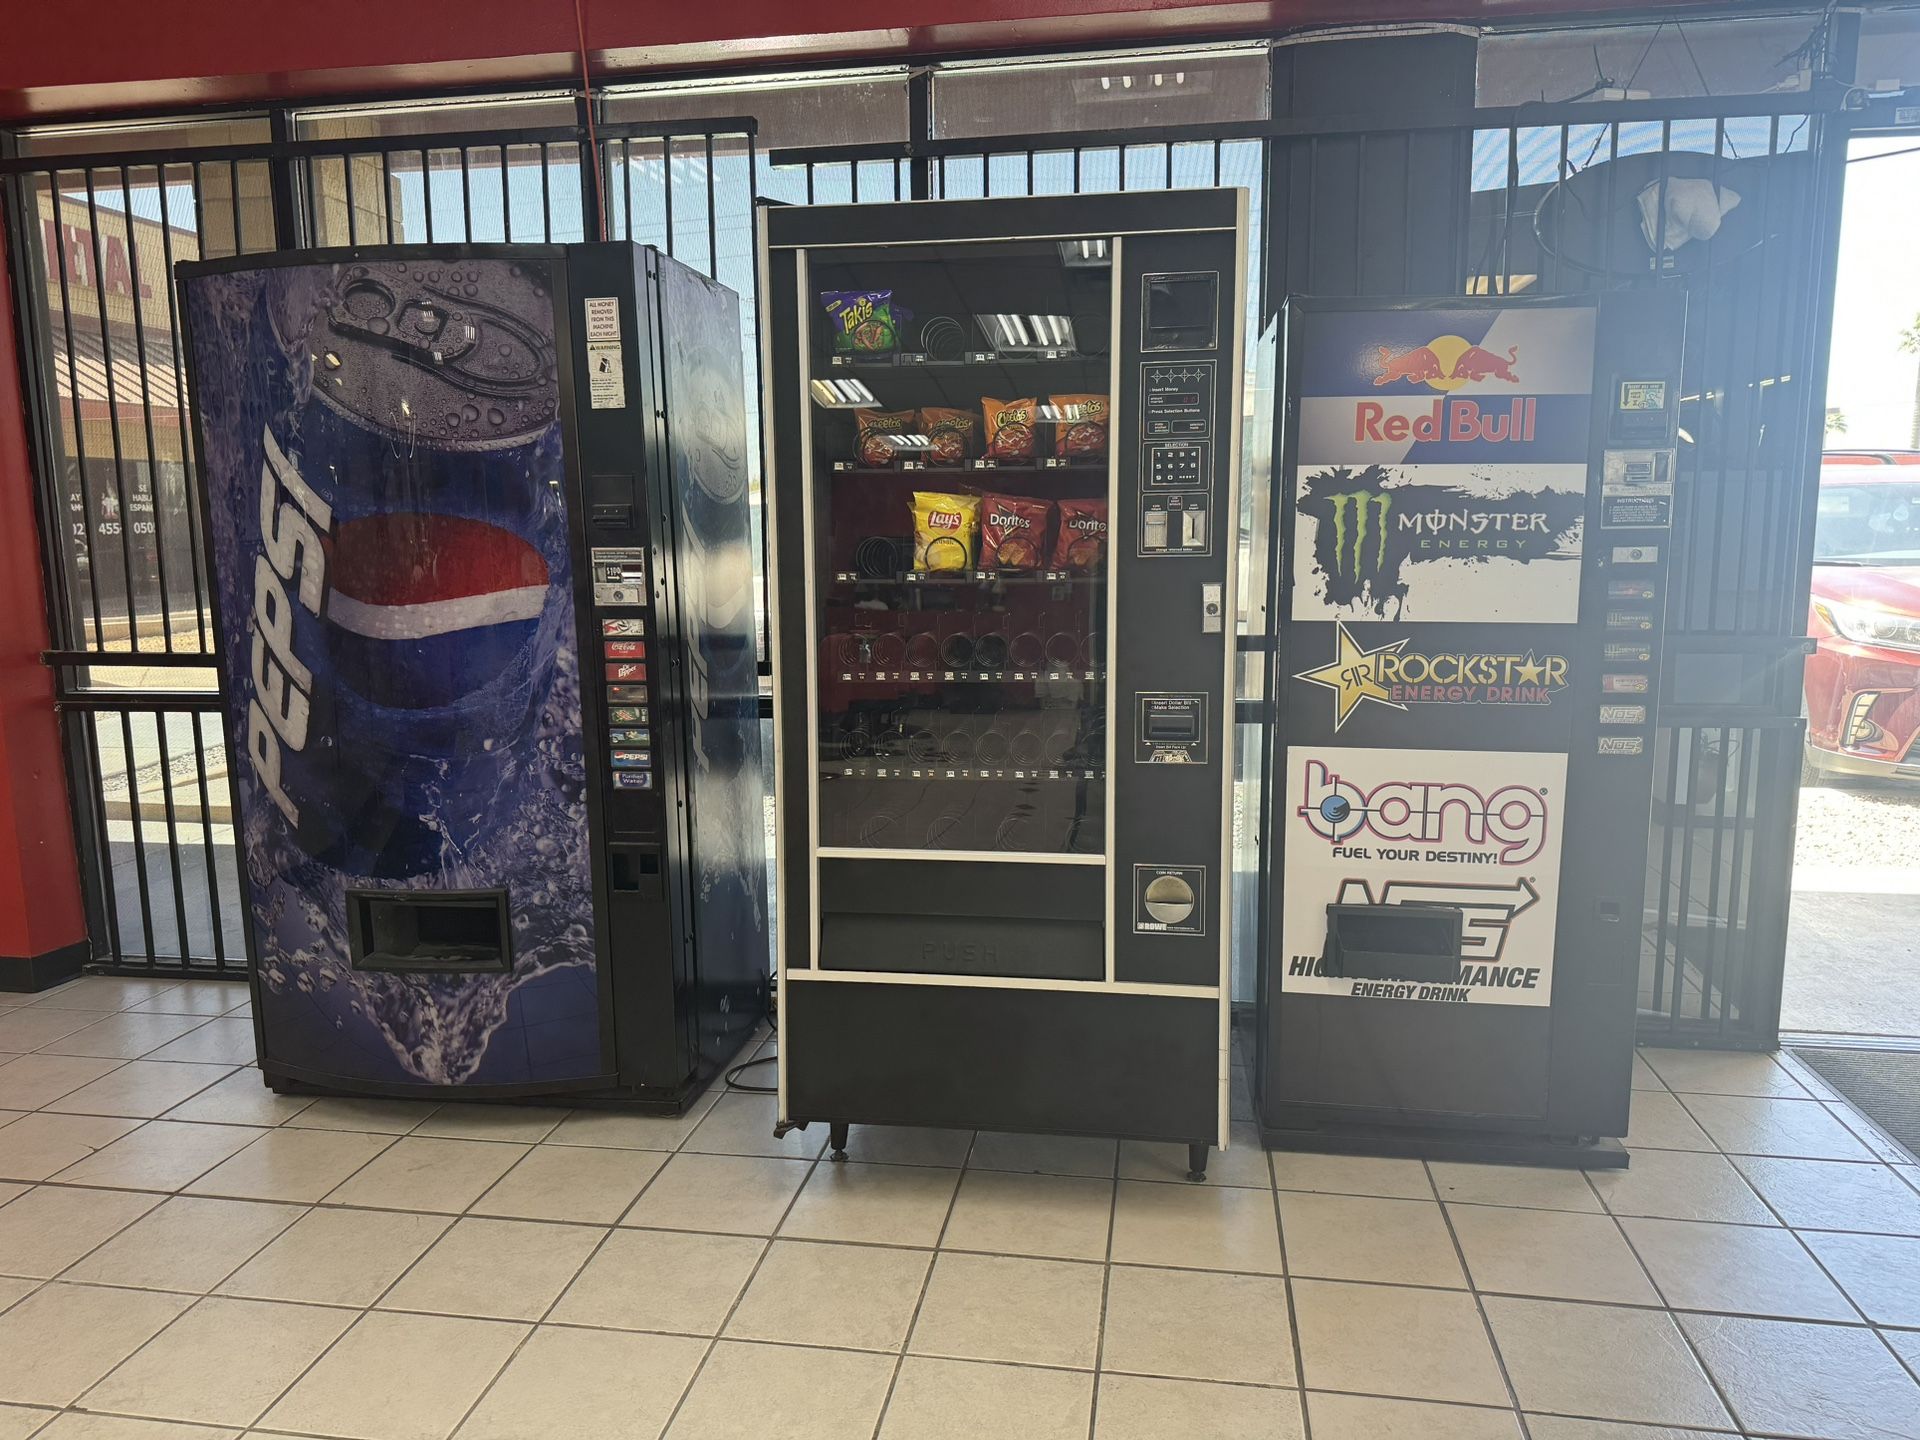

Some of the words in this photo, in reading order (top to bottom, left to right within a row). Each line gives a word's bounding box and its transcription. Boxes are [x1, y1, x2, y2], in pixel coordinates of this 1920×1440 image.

[839, 299, 873, 334] Takis
[996, 409, 1028, 428] Cheetos
[1354, 399, 1444, 442] Red
[1448, 397, 1537, 442] Bull
[138, 484, 147, 492] SE
[133, 522, 156, 534] 050
[930, 511, 961, 529] Lay's
[990, 513, 1031, 529] Doritos
[1398, 508, 1551, 535] MONSTER
[1420, 539, 1528, 549] ENERGY
[248, 422, 332, 830] PEPSI
[1377, 654, 1568, 687] ROCKSTAR
[1391, 684, 1477, 701] ENERGY
[1486, 686, 1551, 703] DRINK
[1600, 705, 1644, 720] NOS
[1598, 736, 1642, 750] NOS
[623, 753, 648, 761] PEPSI
[1297, 759, 1548, 866] bang
[1332, 847, 1371, 860] FUEL
[1376, 849, 1420, 862] YOUR
[1425, 850, 1498, 864] DESTINY!
[1144, 922, 1168, 931] ROWE
[920, 941, 998, 964] PUSH
[1350, 981, 1417, 999] ENERGY
[1417, 984, 1472, 1002] DRINK
